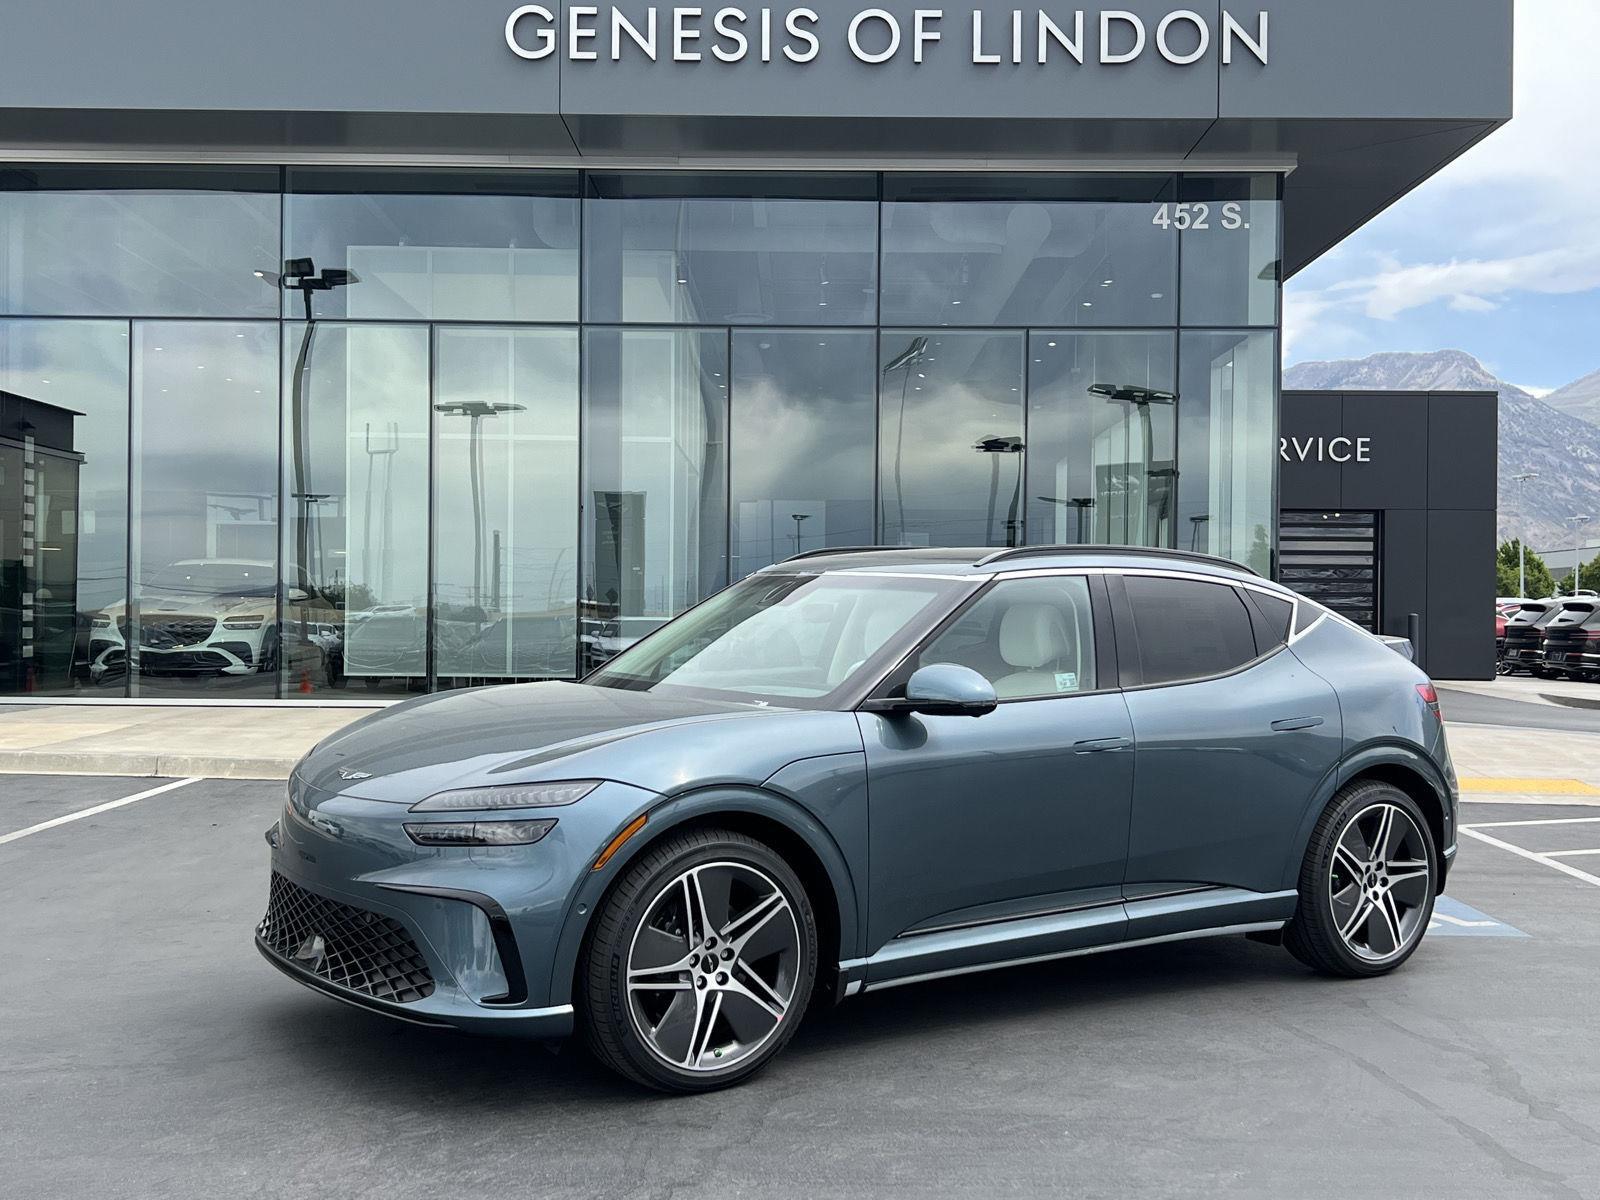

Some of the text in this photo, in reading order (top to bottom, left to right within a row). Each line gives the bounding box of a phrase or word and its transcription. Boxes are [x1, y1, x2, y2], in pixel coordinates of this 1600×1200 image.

[504, 4, 1269, 65] GENESIS OF LINDON
[1152, 202, 1250, 230] 452 S.
